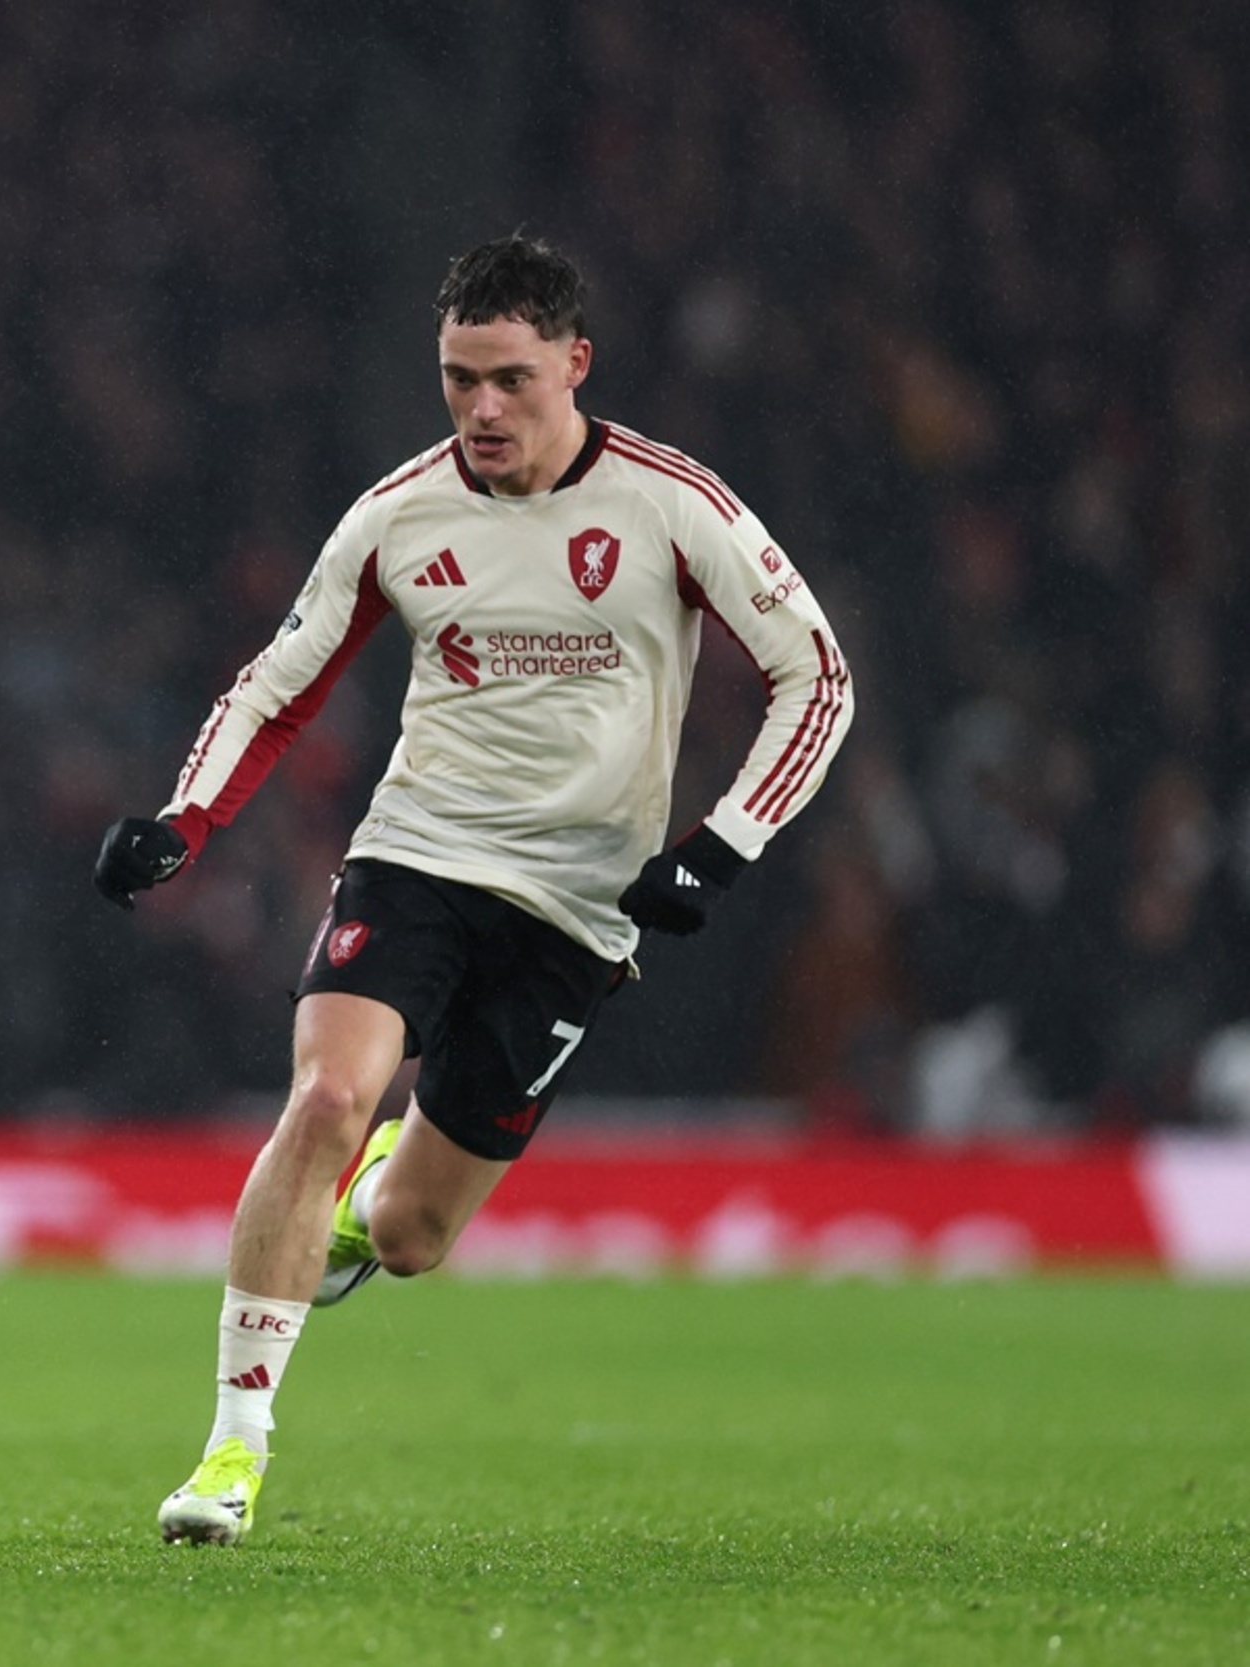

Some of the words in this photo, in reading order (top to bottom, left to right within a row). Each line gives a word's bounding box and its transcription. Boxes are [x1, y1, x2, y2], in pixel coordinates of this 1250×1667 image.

[487, 631, 613, 653] standard
[490, 651, 620, 677] chartered
[525, 1019, 586, 1097] 7
[238, 1311, 290, 1335] LFC
